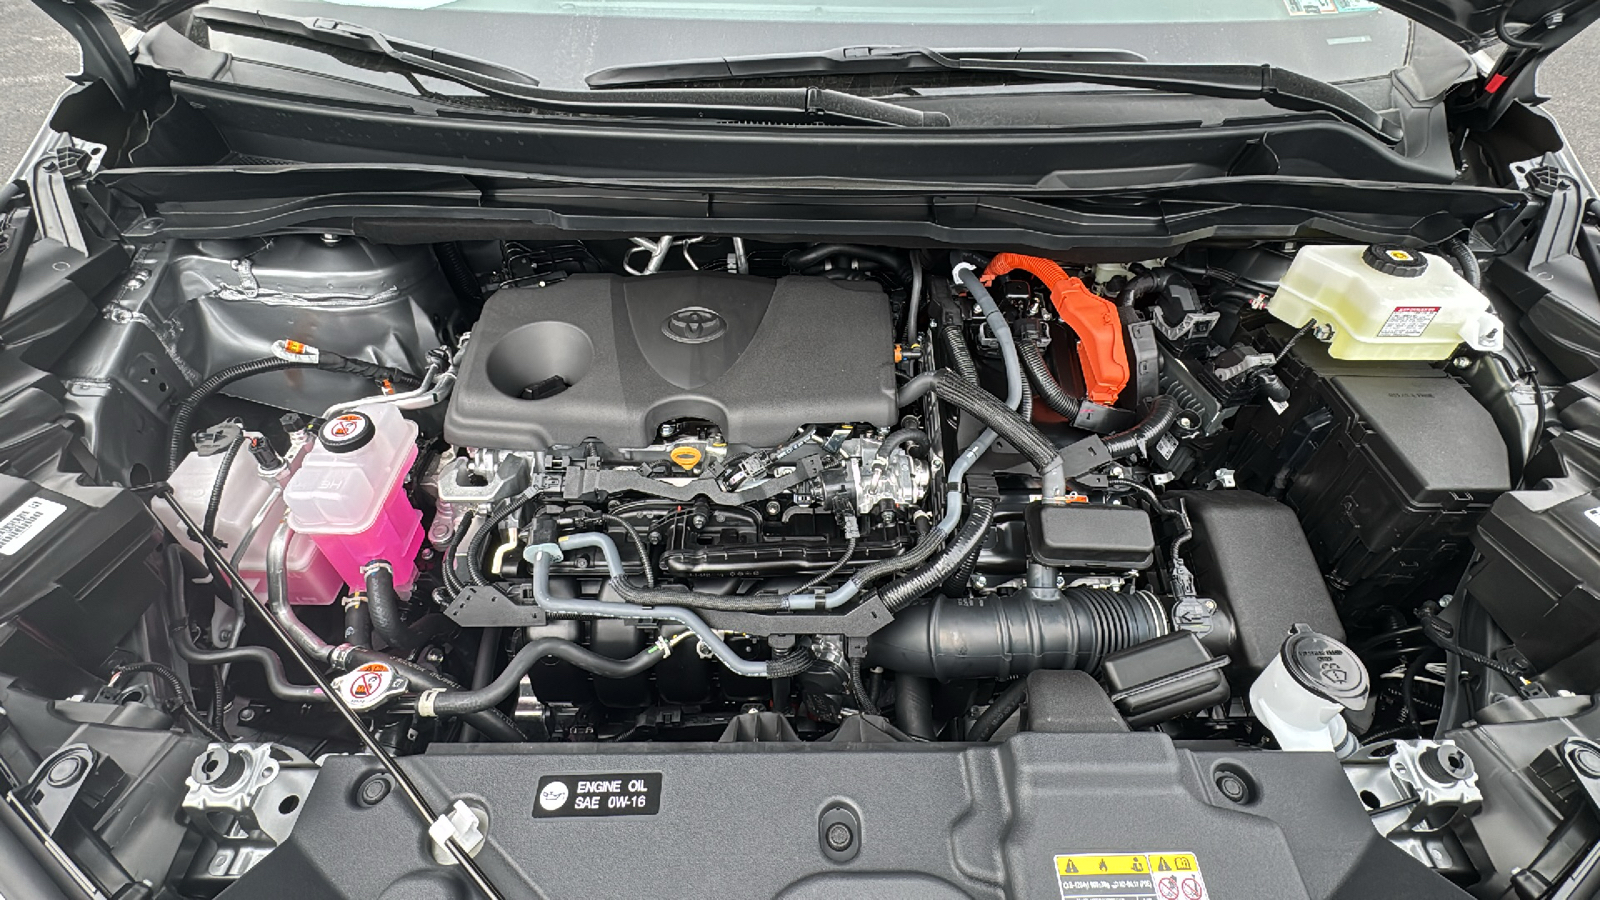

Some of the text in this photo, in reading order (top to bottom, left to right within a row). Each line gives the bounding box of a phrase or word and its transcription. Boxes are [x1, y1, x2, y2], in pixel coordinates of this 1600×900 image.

[577, 779, 648, 794] ENGINE OIL
[574, 795, 646, 809] SAE 0W-16
